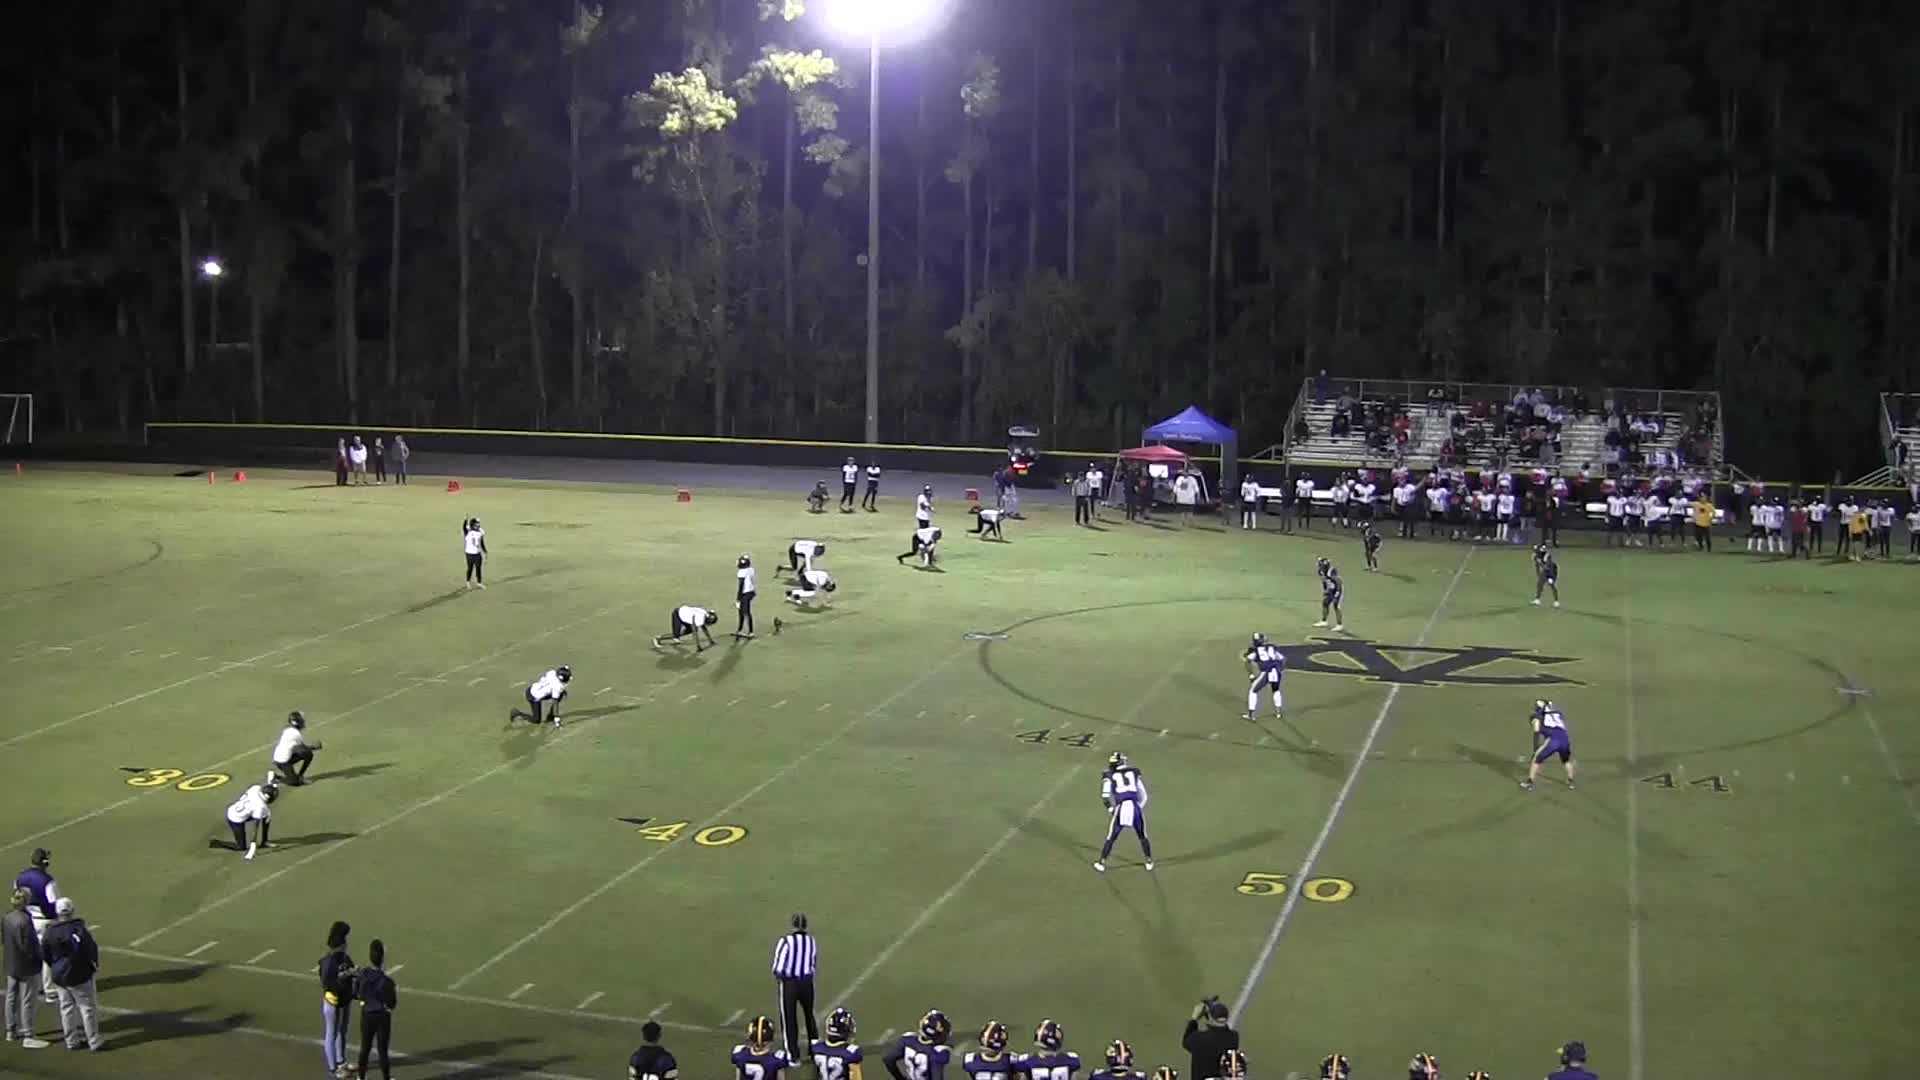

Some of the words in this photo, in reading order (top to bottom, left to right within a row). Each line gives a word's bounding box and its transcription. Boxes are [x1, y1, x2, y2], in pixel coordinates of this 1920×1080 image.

[126, 768, 231, 791] 30
[1112, 771, 1138, 794] 11
[637, 819, 748, 846] 40
[1235, 871, 1356, 902] 50
